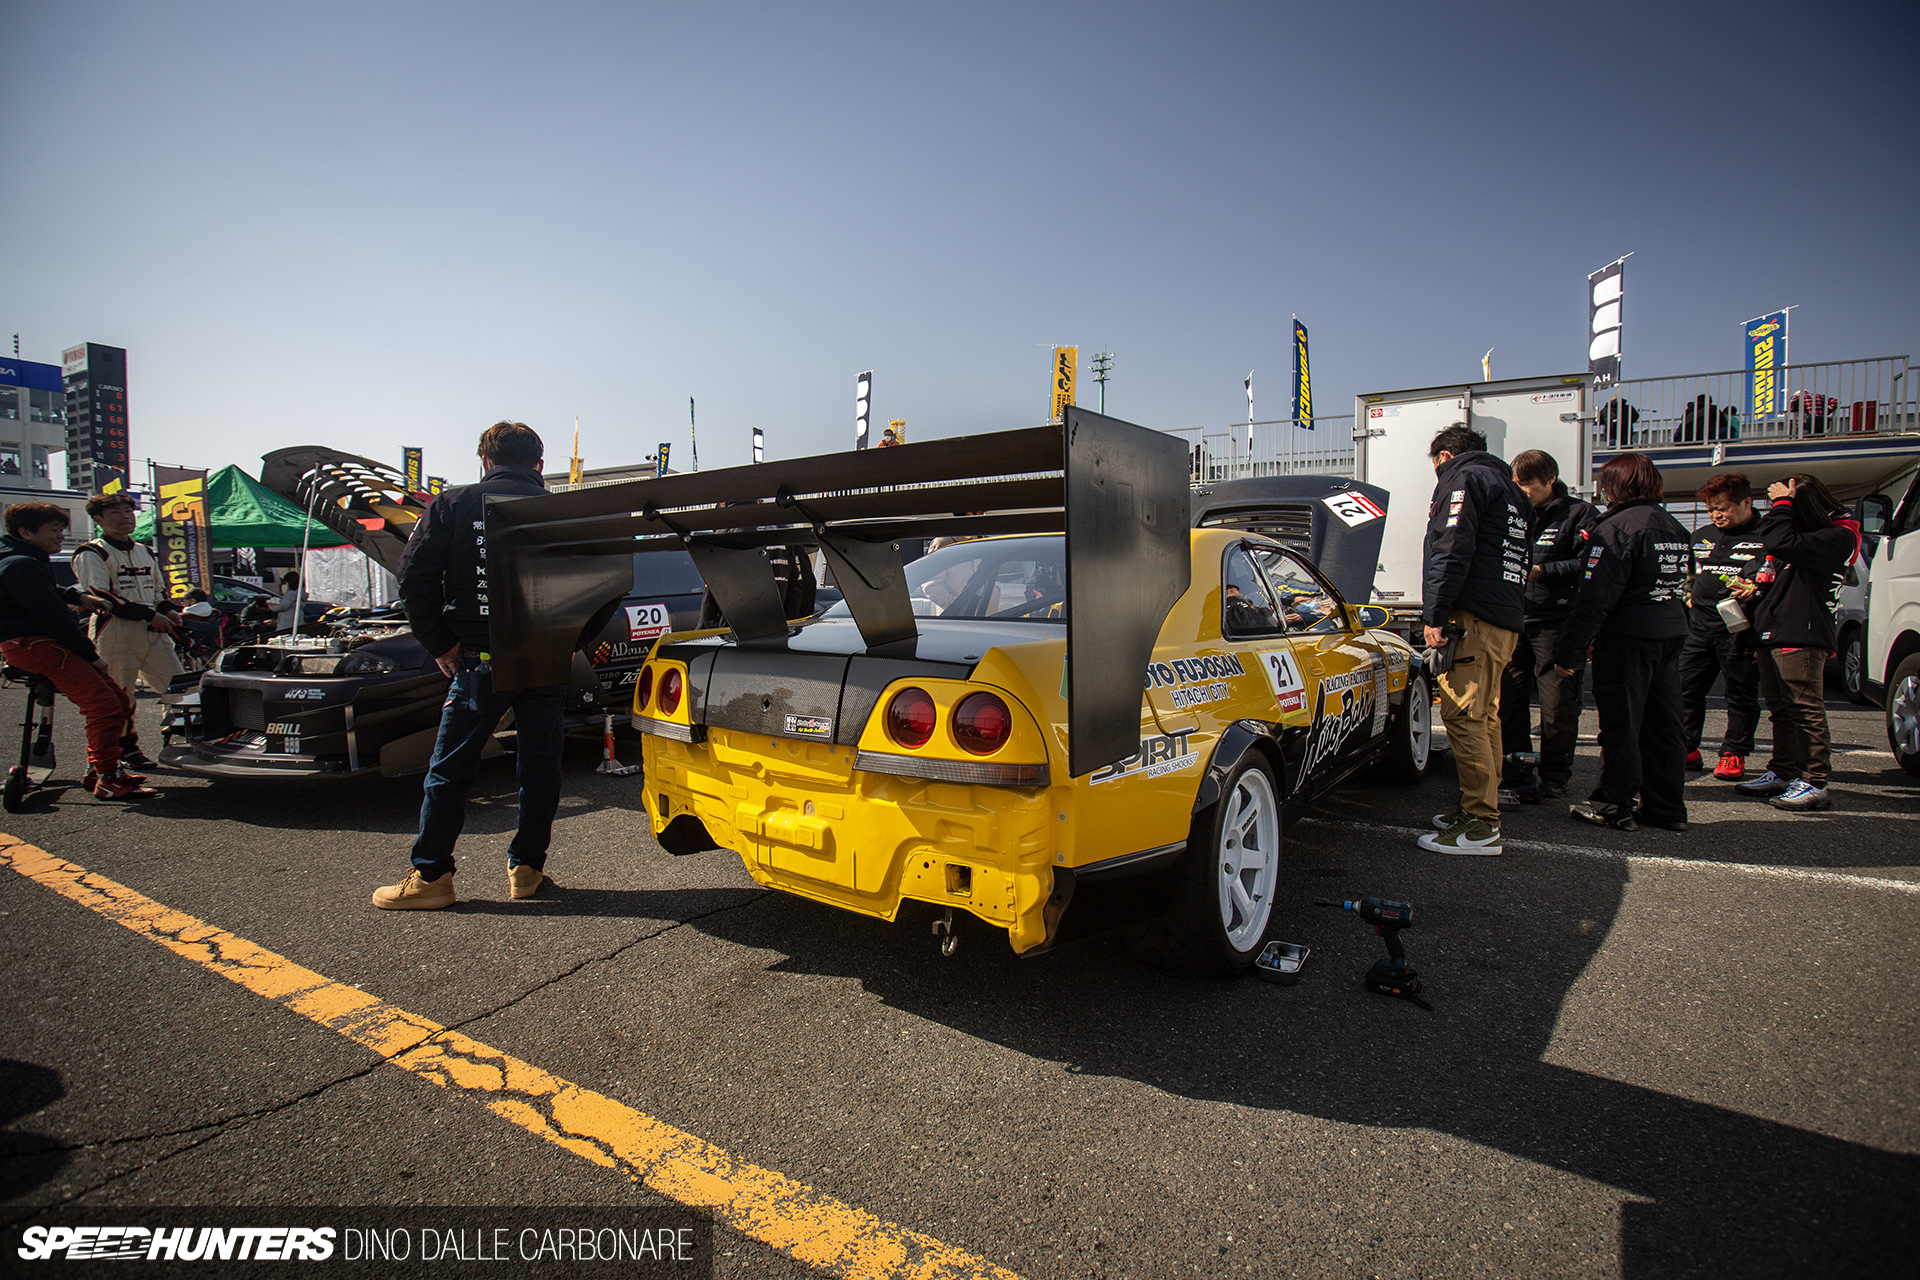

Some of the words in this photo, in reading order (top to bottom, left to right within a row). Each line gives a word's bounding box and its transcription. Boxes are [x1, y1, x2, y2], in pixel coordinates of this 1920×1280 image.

[1299, 342, 1311, 428] SUNOCO
[115, 392, 123, 400] 8
[108, 403, 123, 412] 61
[109, 416, 124, 425] 68
[109, 428, 124, 437] 66
[110, 440, 125, 449] 65
[1333, 501, 1367, 517] 21
[1719, 565, 1742, 573] FUDOS
[637, 607, 662, 626] 20
[632, 629, 660, 637] POTENZA
[1170, 653, 1246, 684] FUDOSAN
[1269, 654, 1295, 689] 21
[1325, 673, 1349, 694] RACING
[1349, 668, 1373, 688] FACTORY
[1170, 685, 1212, 709] HITACHI
[1208, 682, 1231, 700] CITY
[1280, 695, 1300, 708] POTENZA
[265, 722, 301, 735] BRILL
[1148, 763, 1172, 779] RACING
[1171, 757, 1194, 772] SHOCKS
